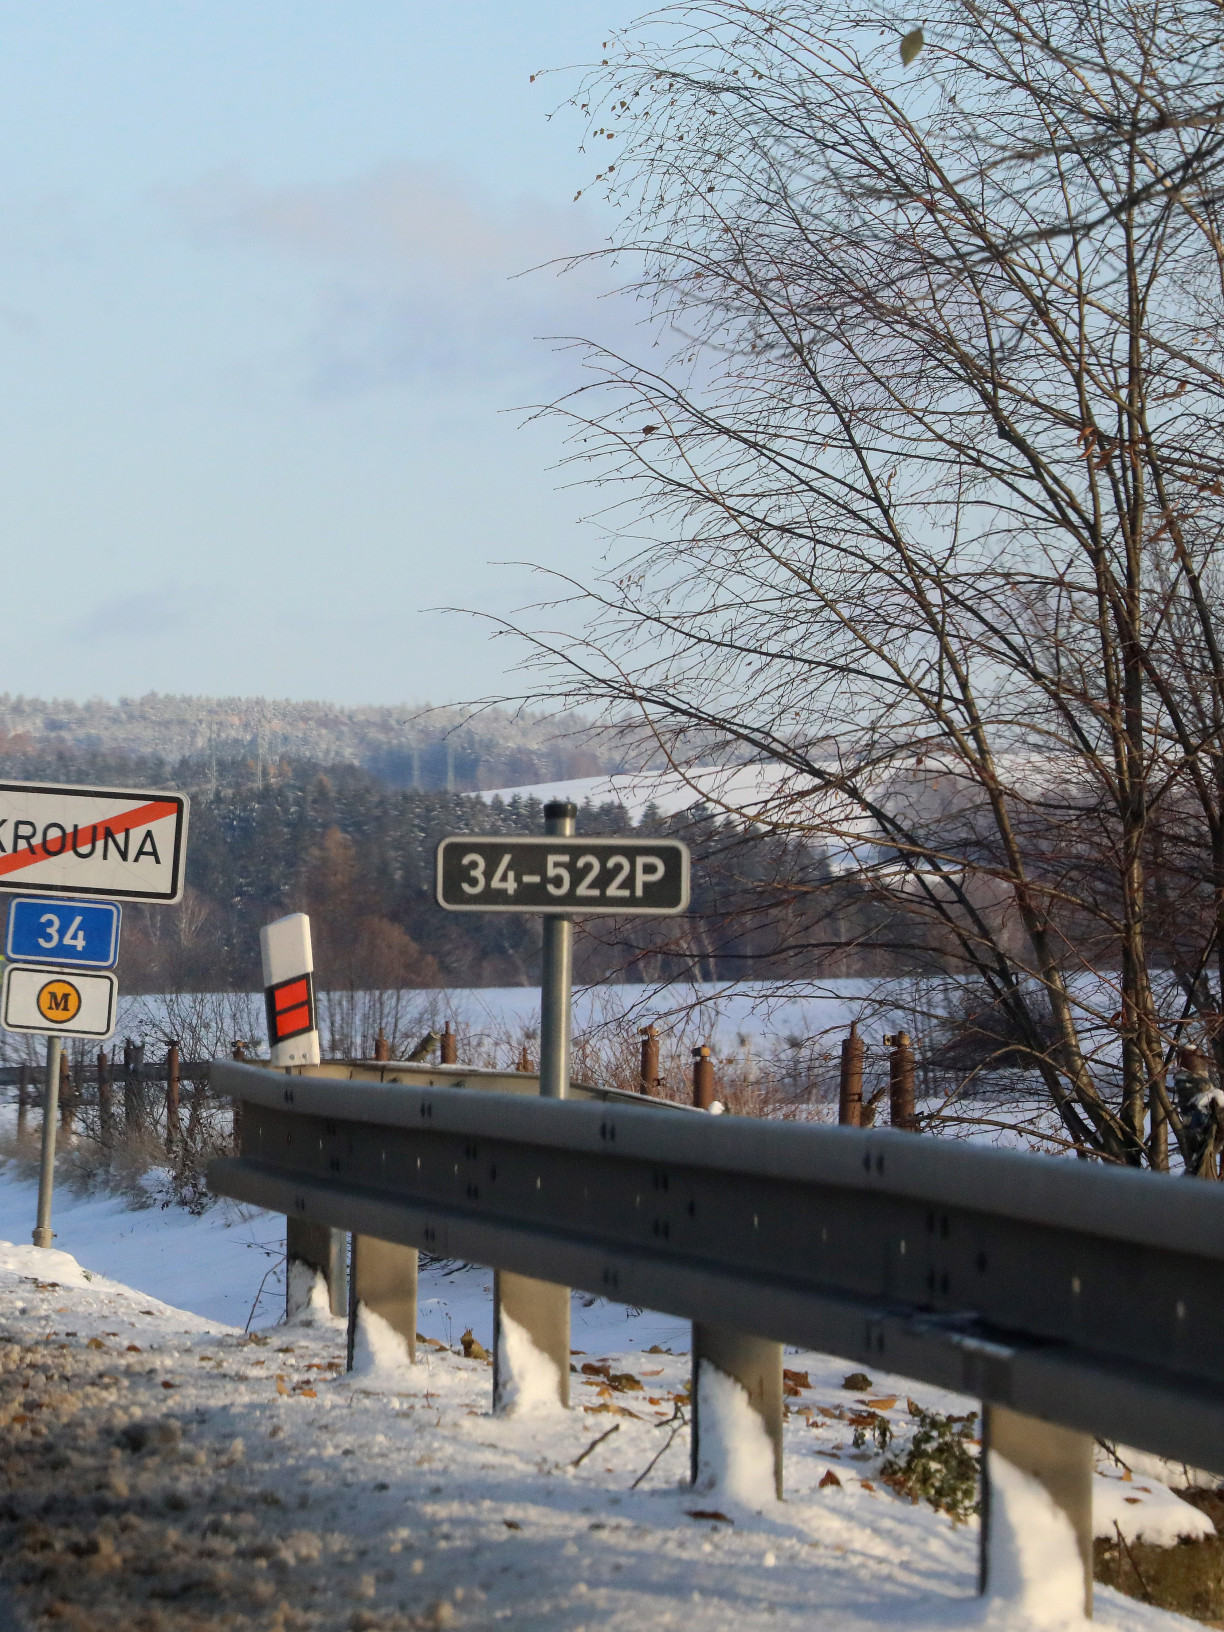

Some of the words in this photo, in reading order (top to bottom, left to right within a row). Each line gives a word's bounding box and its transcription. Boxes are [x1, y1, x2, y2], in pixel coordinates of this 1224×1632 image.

[460, 852, 666, 898] 34-522P
[37, 913, 87, 952] 34
[46, 991, 72, 1013] M
